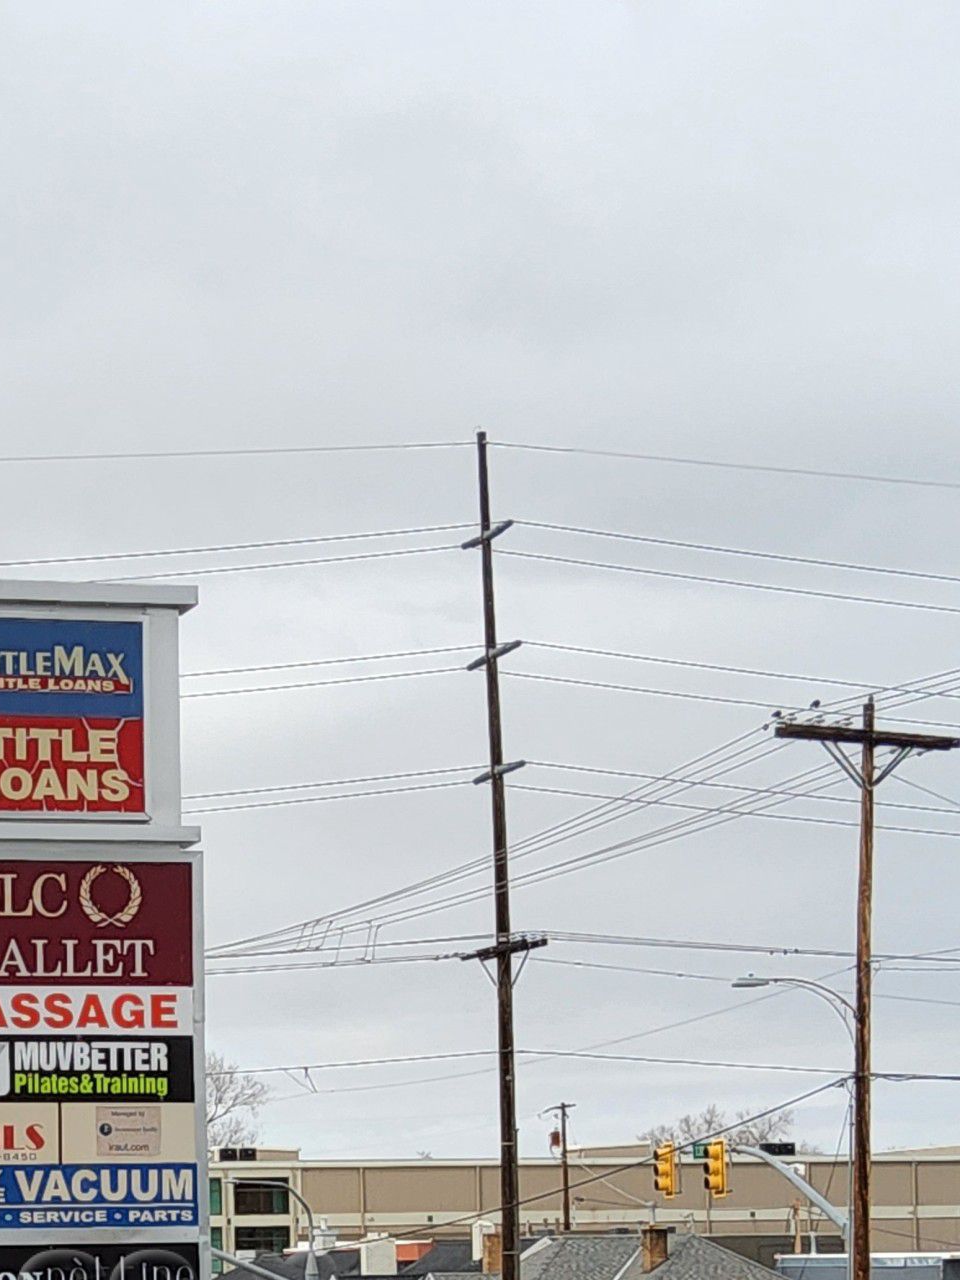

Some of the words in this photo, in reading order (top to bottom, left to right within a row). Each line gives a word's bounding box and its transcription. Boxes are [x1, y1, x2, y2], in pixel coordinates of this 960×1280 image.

[48, 678, 115, 693] LOANS
[14, 1041, 169, 1072] MUVBETTER
[14, 1168, 194, 1202] VACUUM
[19, 1210, 108, 1223] SERVICE
[128, 1209, 194, 1222] PARTS
